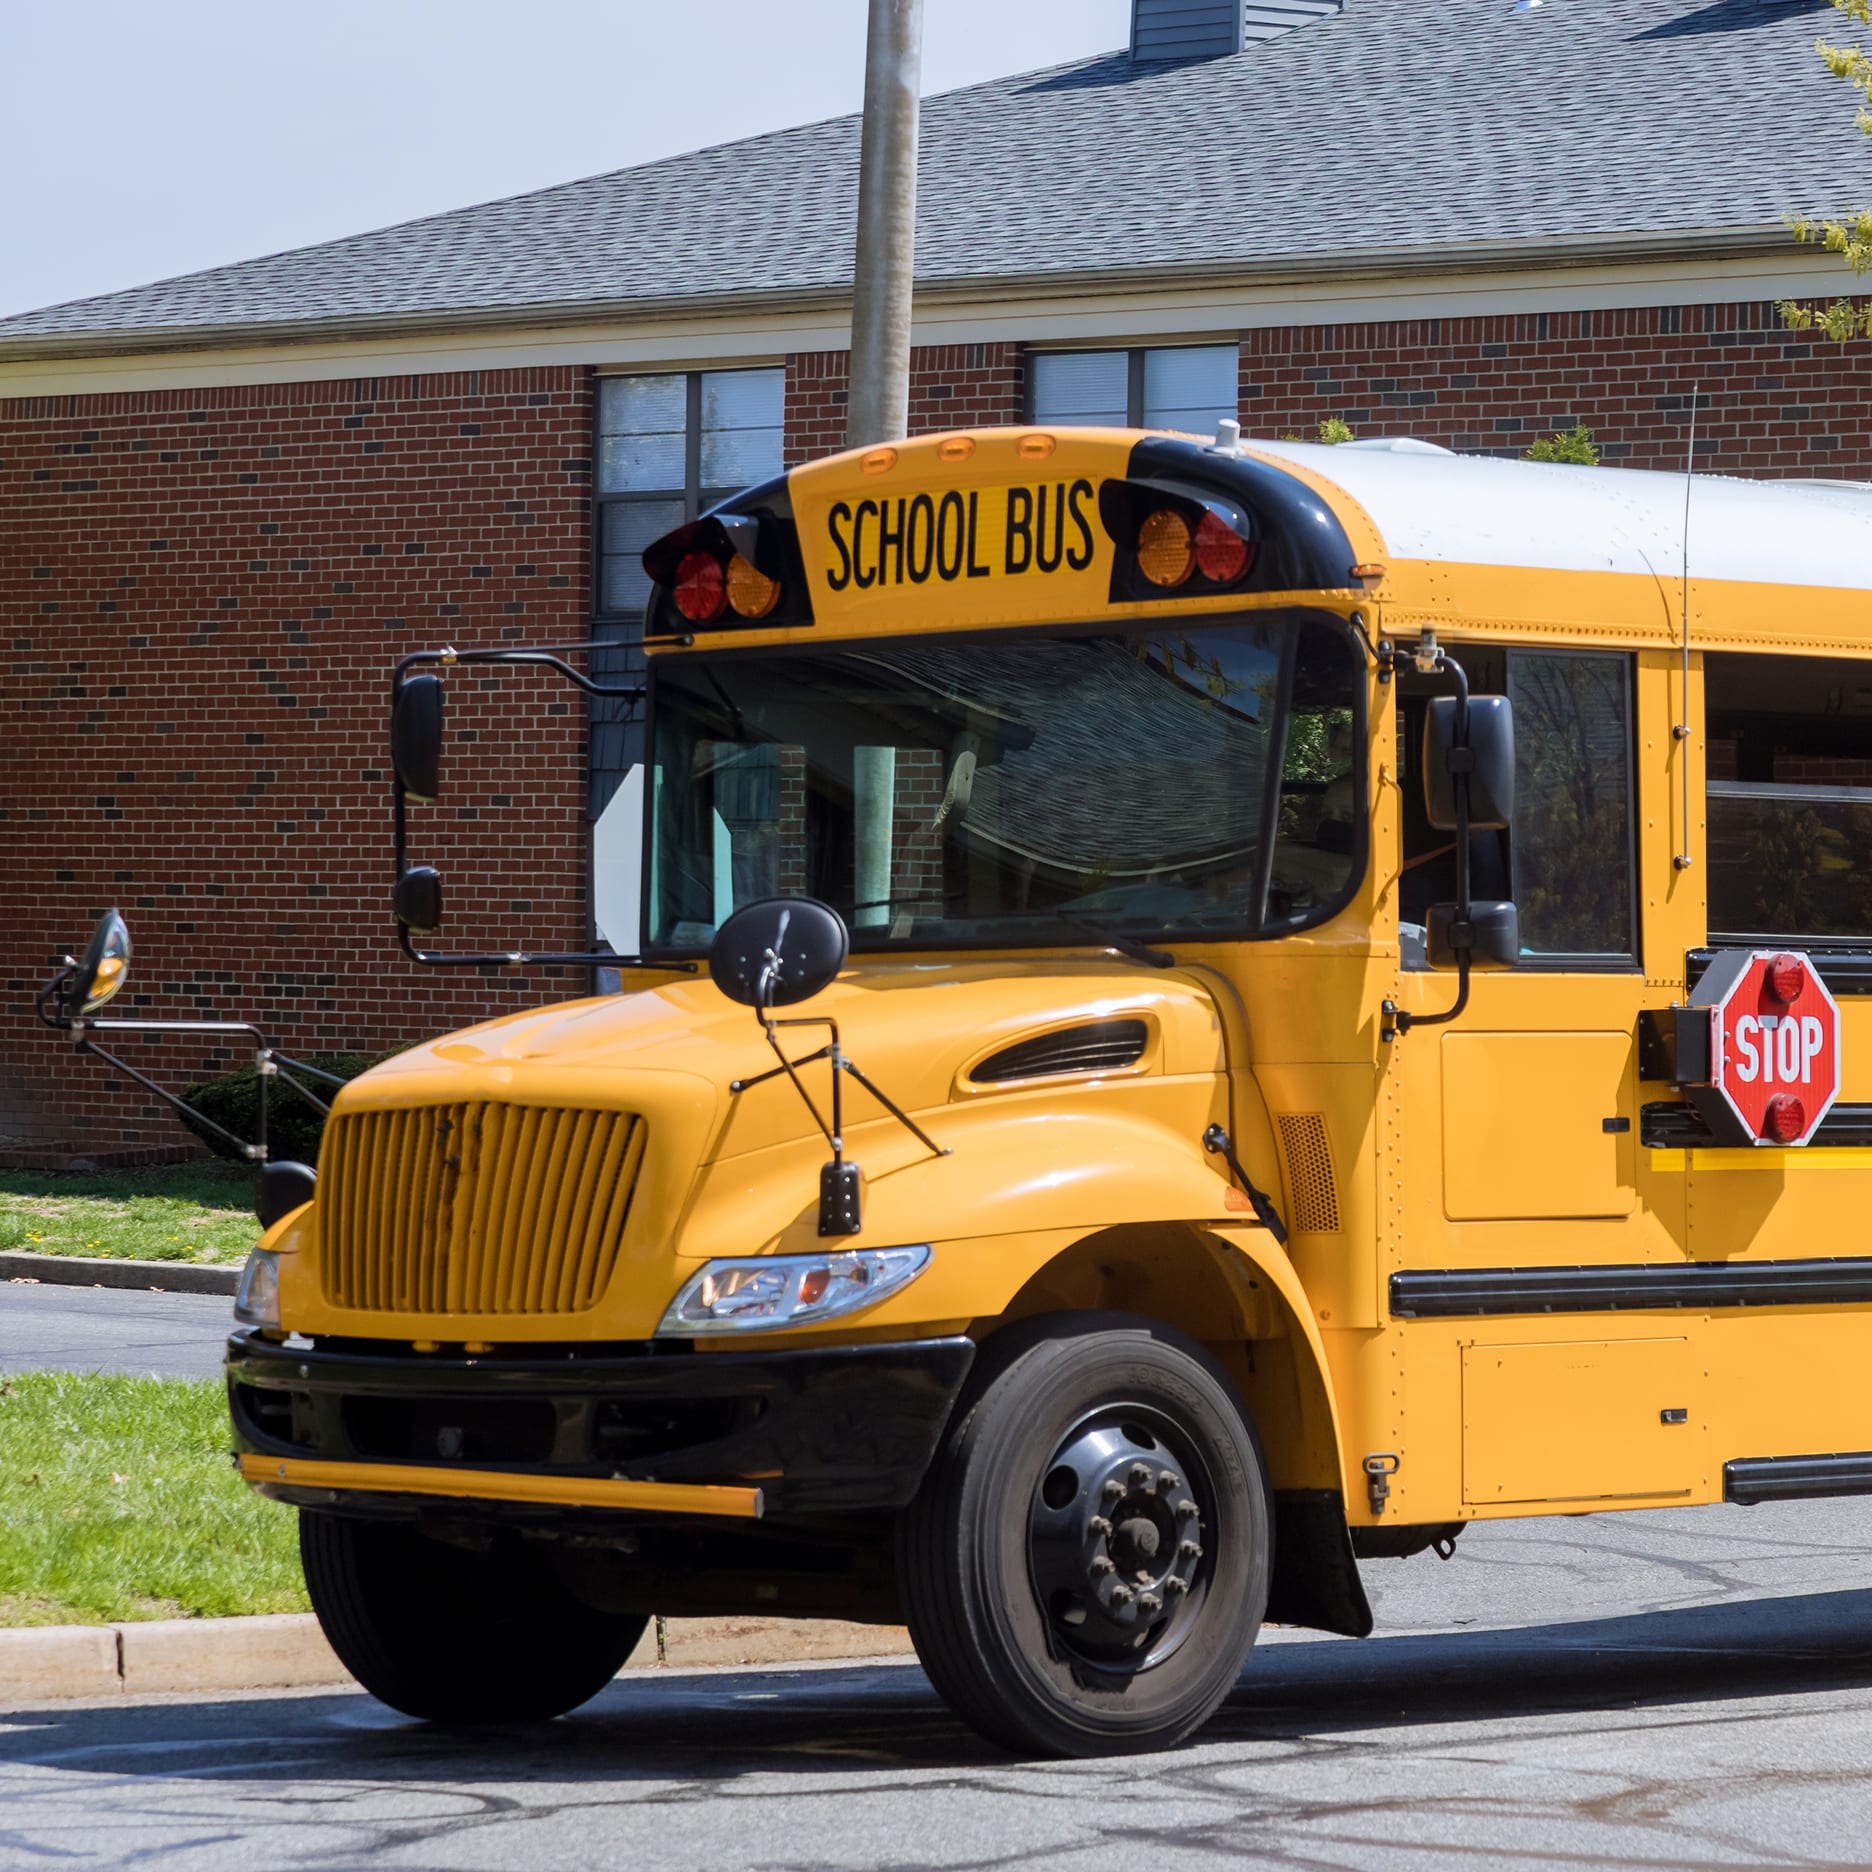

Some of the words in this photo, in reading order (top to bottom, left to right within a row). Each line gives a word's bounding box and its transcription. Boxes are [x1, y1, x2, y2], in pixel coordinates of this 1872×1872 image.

[827, 490, 990, 592] SCHOOL
[1005, 479, 1094, 575] BUS
[1735, 1014, 1824, 1084] STOP
